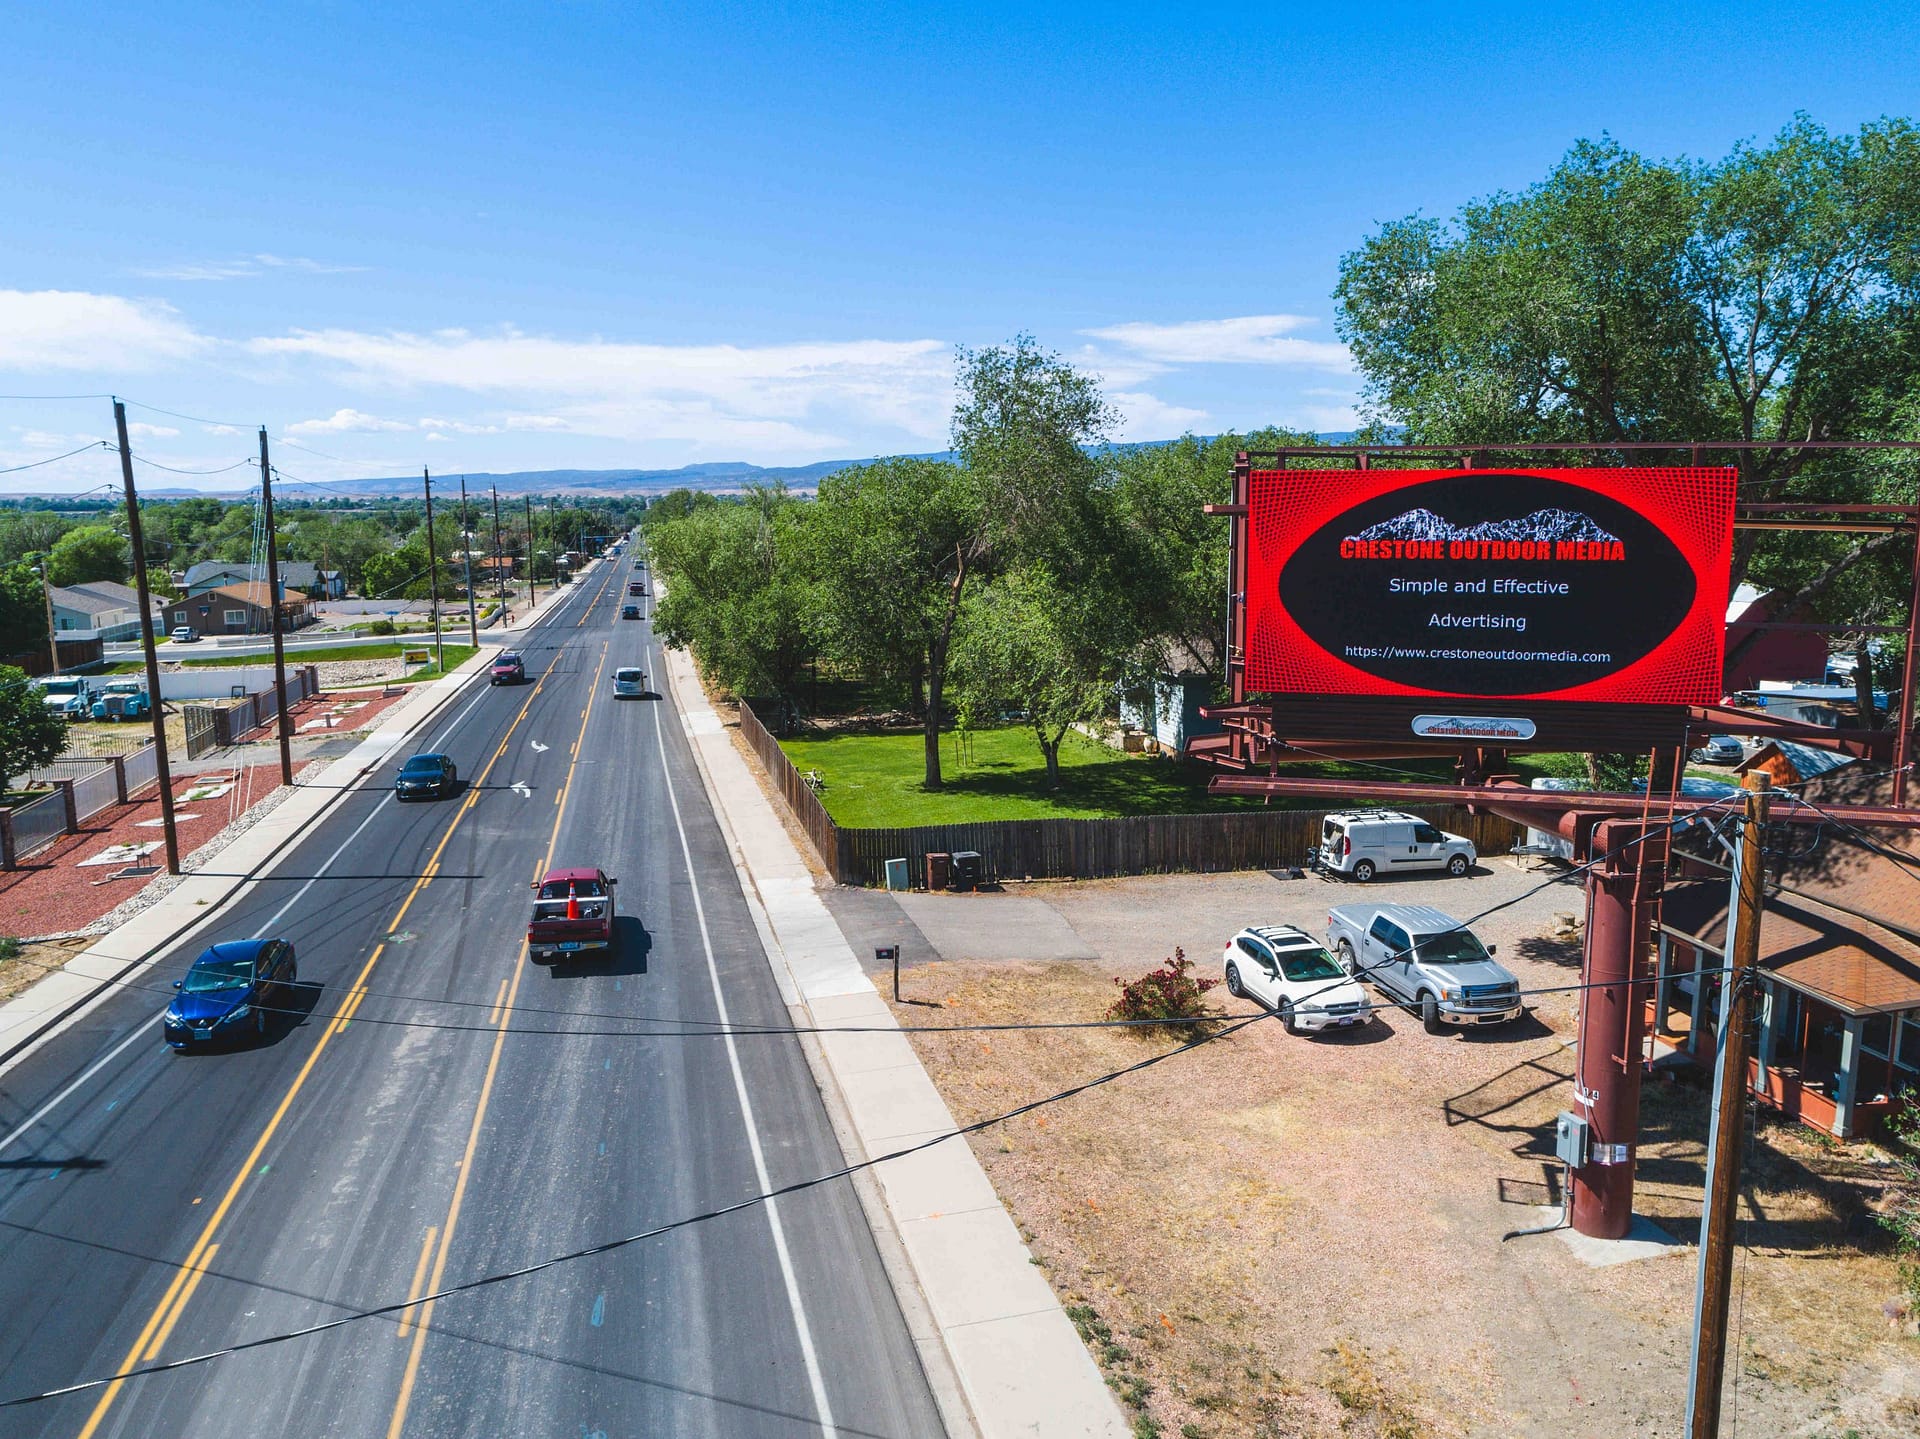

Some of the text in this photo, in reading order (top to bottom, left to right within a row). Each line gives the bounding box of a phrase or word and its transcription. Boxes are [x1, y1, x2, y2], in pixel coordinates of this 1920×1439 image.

[1340, 540, 1626, 561] CRESTONE OUTDOOR MEDIA
[1389, 578, 1569, 595] Simple and Effective
[1428, 613, 1526, 631] Advertising
[1345, 645, 1611, 662] https://www.crestoneoutdoormedia.com
